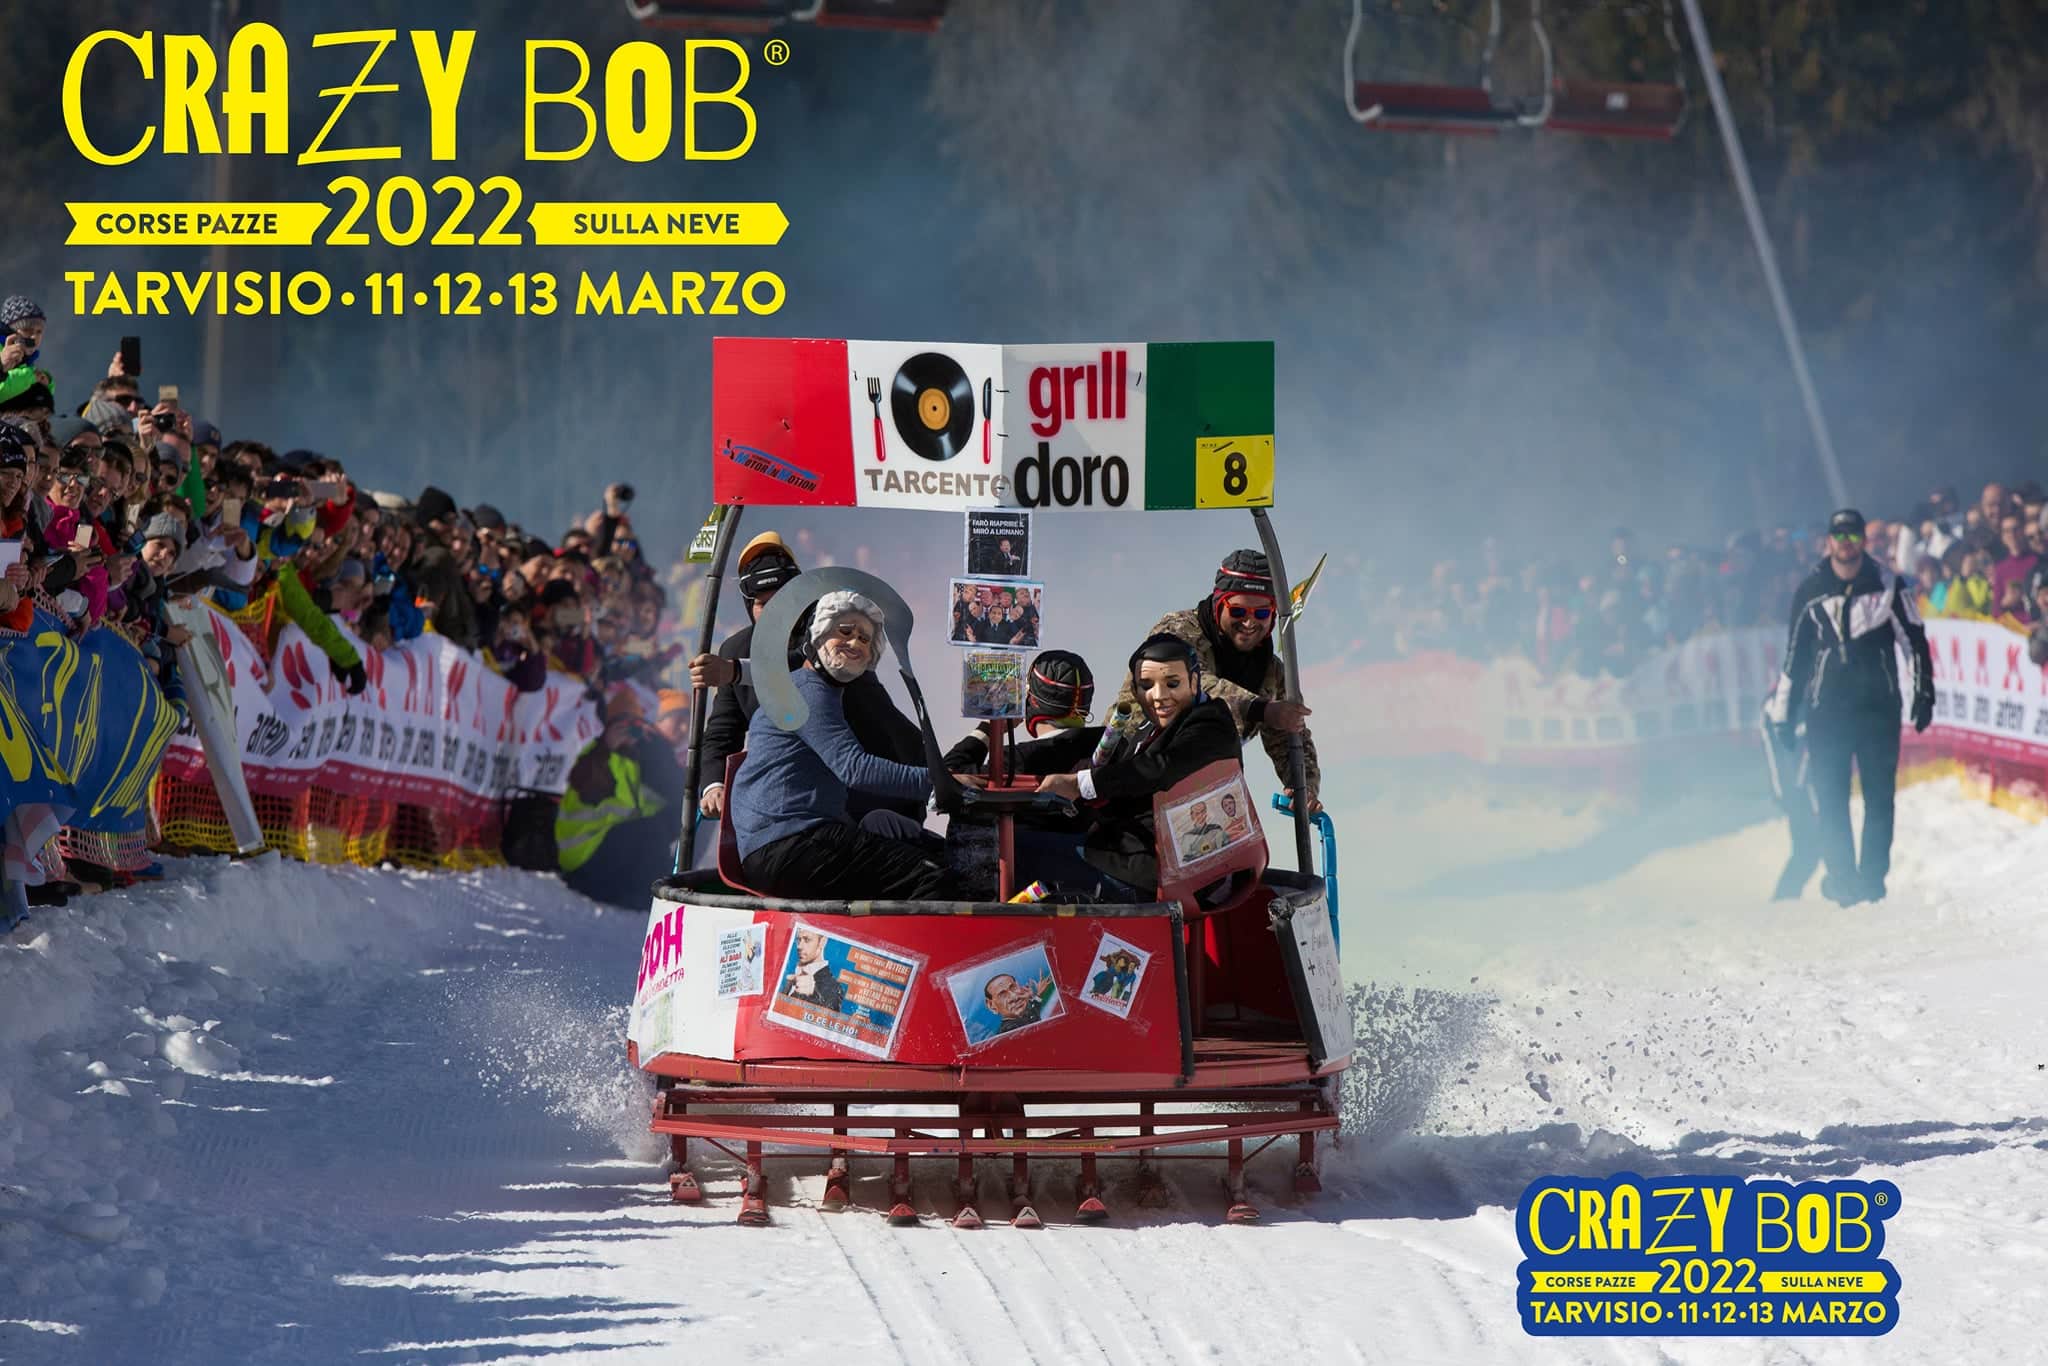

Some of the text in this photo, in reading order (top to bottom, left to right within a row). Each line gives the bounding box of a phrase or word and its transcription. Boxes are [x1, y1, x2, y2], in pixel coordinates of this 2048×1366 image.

[1029, 351, 1128, 437] grill
[864, 468, 1011, 498] TARCENTO
[1014, 442, 1129, 507] doro
[1223, 452, 1249, 496] 8
